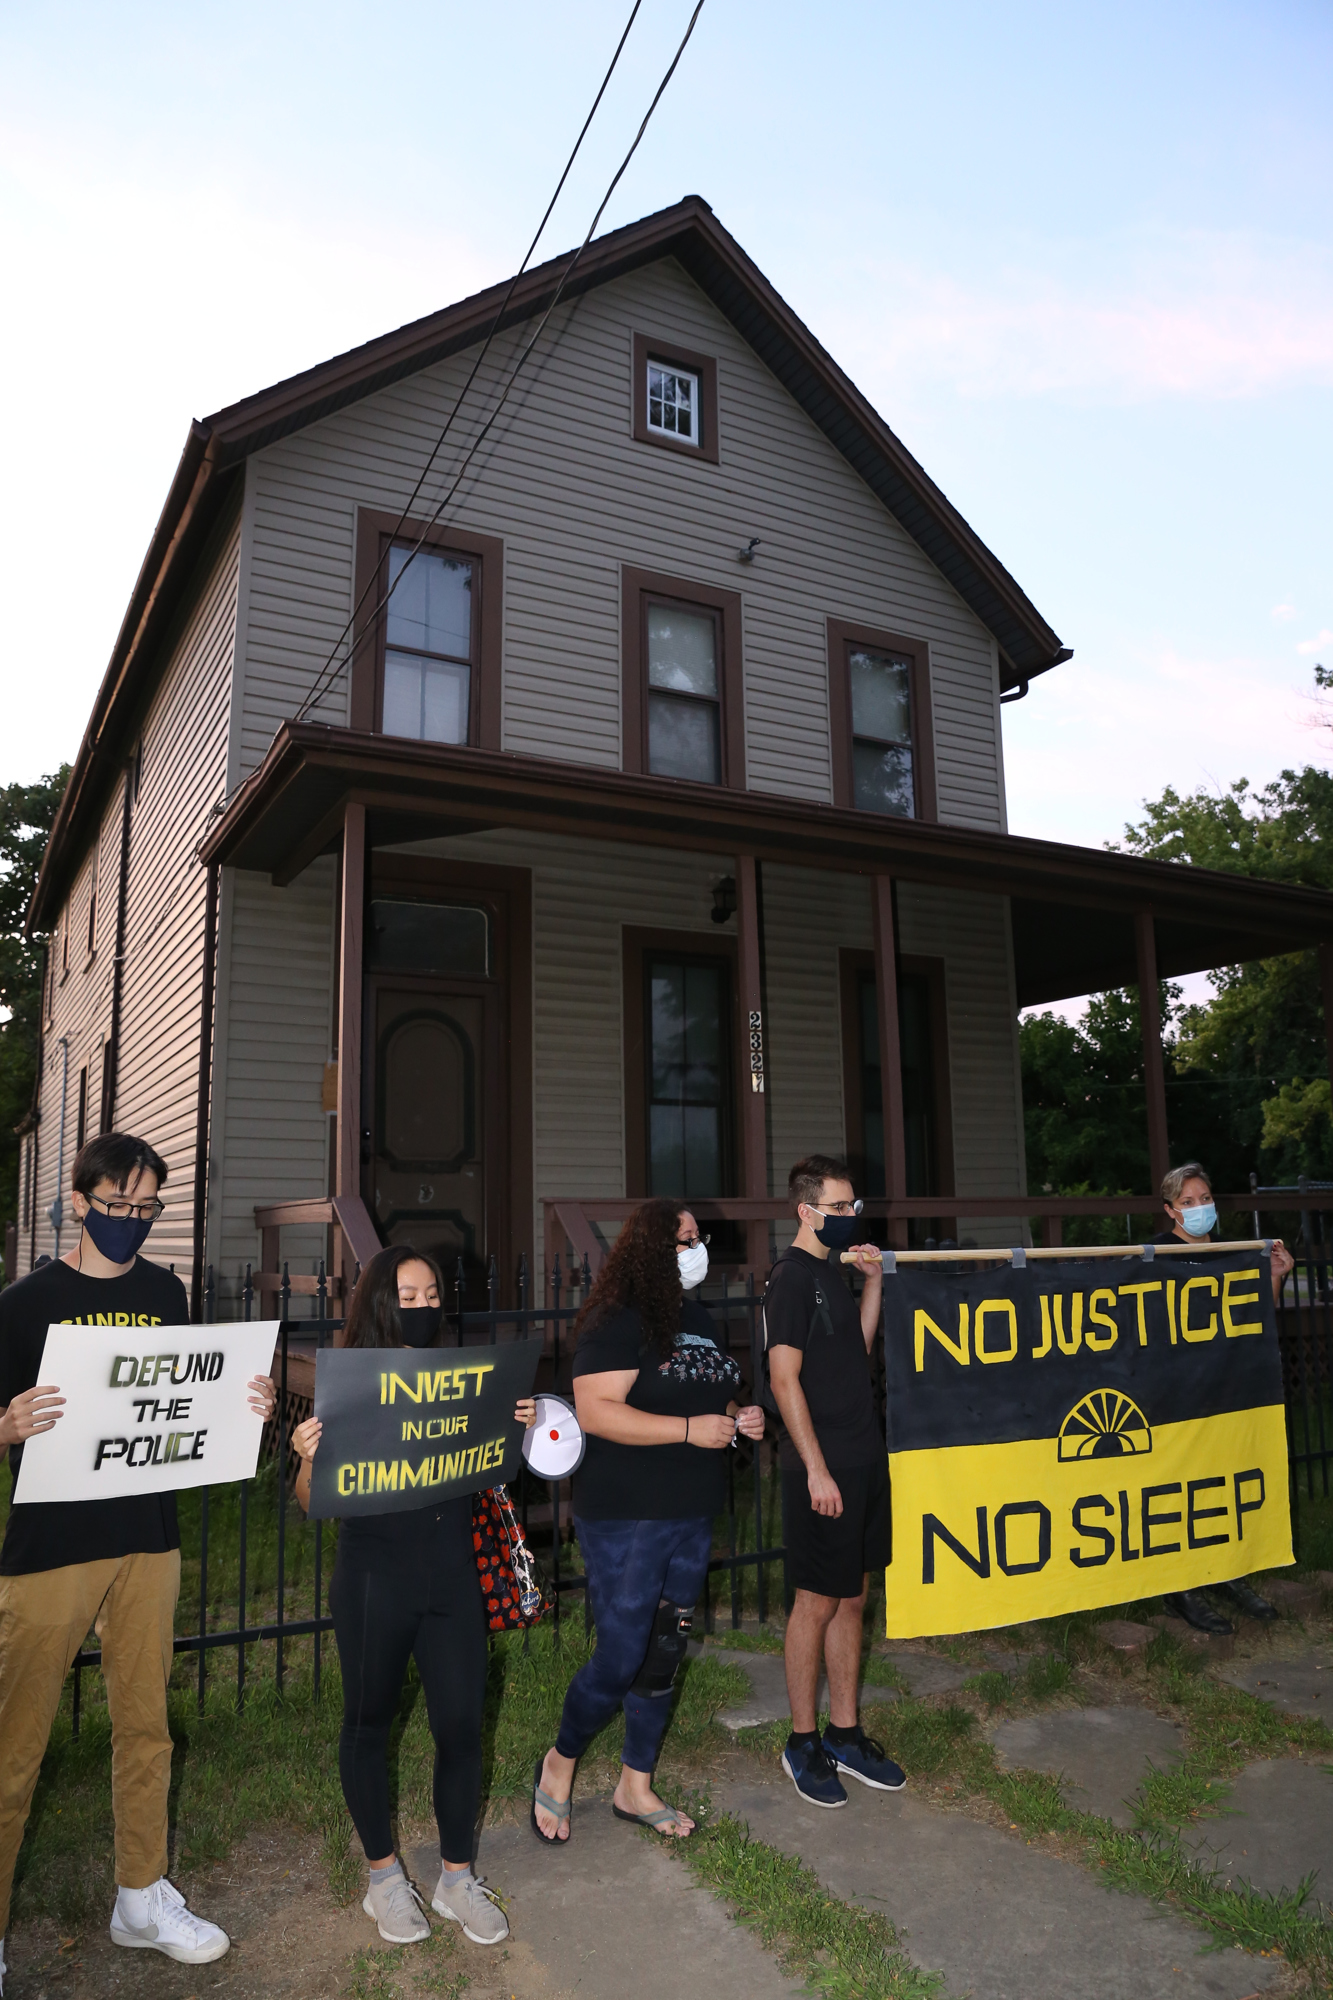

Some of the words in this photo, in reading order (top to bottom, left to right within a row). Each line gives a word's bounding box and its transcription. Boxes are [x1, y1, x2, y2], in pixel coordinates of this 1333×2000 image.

[750, 1012, 763, 1092] 2327
[913, 1298, 1018, 1373] NO
[1032, 1268, 1263, 1359] JUSTICE
[109, 1351, 225, 1388] DEFUND
[380, 1364, 494, 1405] INVEST
[132, 1397, 193, 1423] THE
[401, 1420, 423, 1441] IN
[426, 1415, 469, 1439] OUR
[93, 1429, 208, 1471] POLICE
[337, 1437, 506, 1496] COMMUNITIES
[922, 1500, 1052, 1585] NO
[1069, 1467, 1266, 1569] SLEEP
